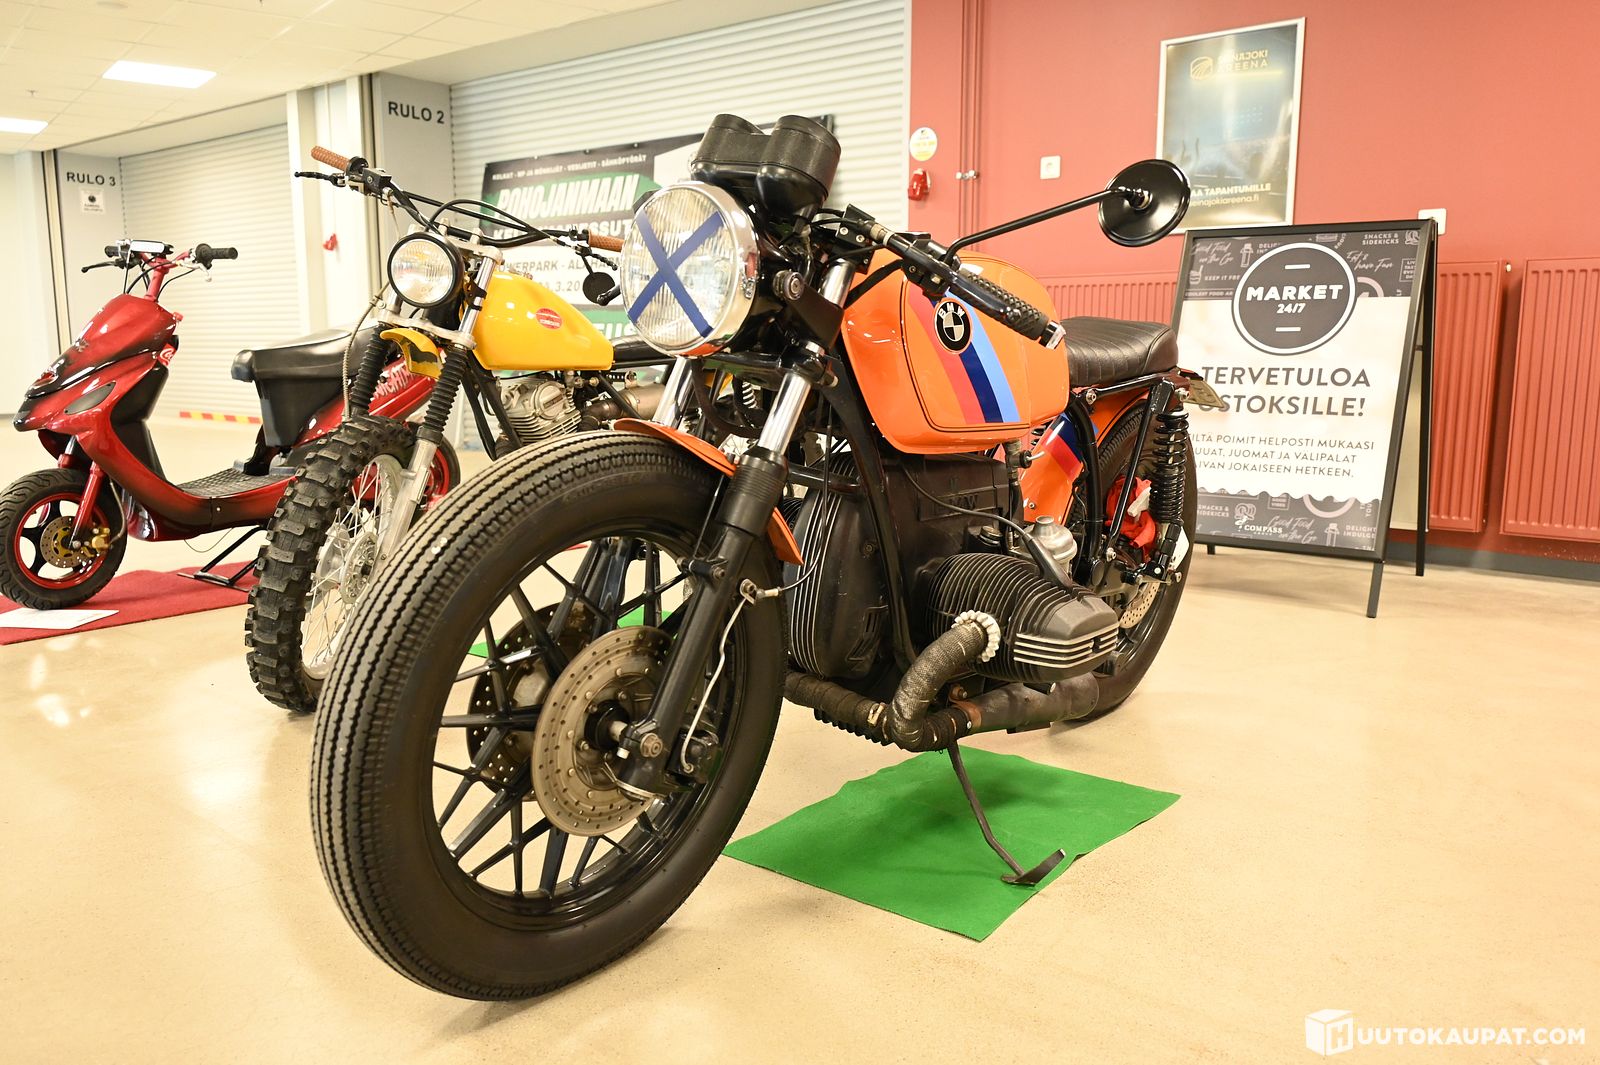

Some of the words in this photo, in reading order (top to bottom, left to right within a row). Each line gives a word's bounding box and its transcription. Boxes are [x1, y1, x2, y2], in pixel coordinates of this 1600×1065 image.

[388, 101, 432, 122] RULO
[437, 110, 444, 124] 2
[66, 171, 105, 186] RULO
[109, 176, 116, 187] 3
[498, 259, 559, 272] OWERPARK
[1246, 284, 1344, 301] MARKET
[938, 302, 966, 319] BMW
[1276, 302, 1307, 314] 24/7
[1201, 366, 1371, 388] TERVETULOA
[1216, 434, 1256, 445] POIMIT
[1258, 436, 1314, 448] HELPOSTI
[1317, 439, 1375, 450] MUKAASI
[1194, 447, 1225, 457] UUAT,
[1229, 448, 1276, 459] JUOMAT
[1278, 450, 1291, 460] JA
[1294, 450, 1358, 463] VÄLIPALAT
[1228, 462, 1292, 474] JOKAISEEN
[1295, 466, 1354, 478] HETKEEN.
[1244, 524, 1283, 534] COMPASS
